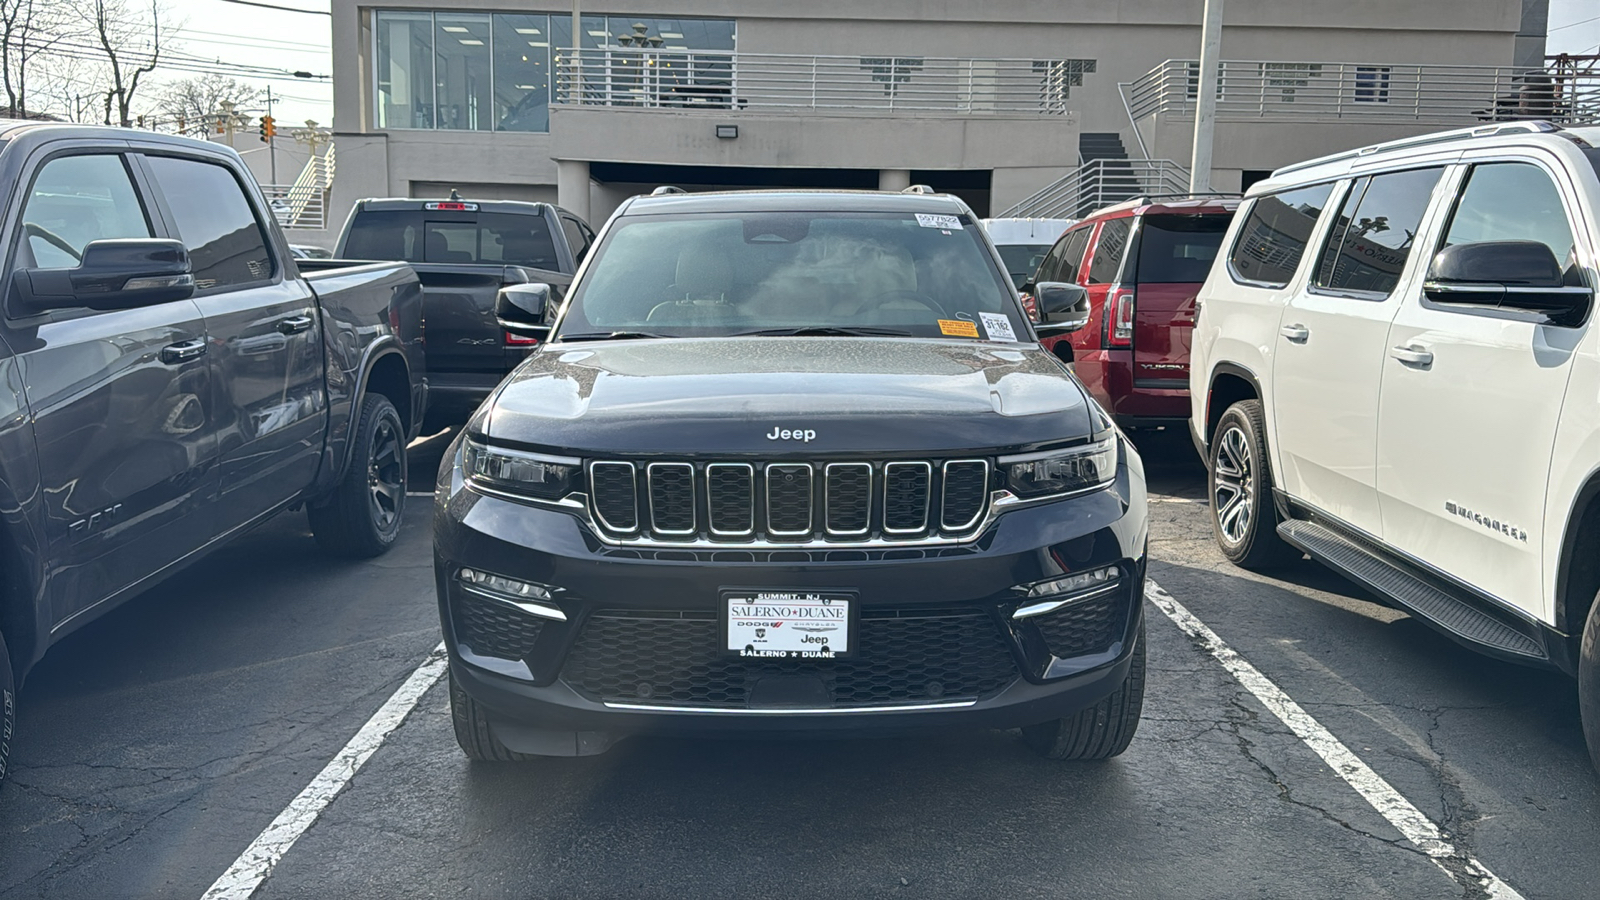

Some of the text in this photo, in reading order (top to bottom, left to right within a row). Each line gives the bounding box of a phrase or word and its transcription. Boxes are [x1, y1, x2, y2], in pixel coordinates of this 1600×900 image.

[766, 426, 816, 443] Jeep
[1458, 506, 1527, 543] WAGONEER
[731, 606, 845, 619] SALERNO DUANE
[800, 634, 829, 645] Jeep
[739, 650, 787, 658] SALERNO
